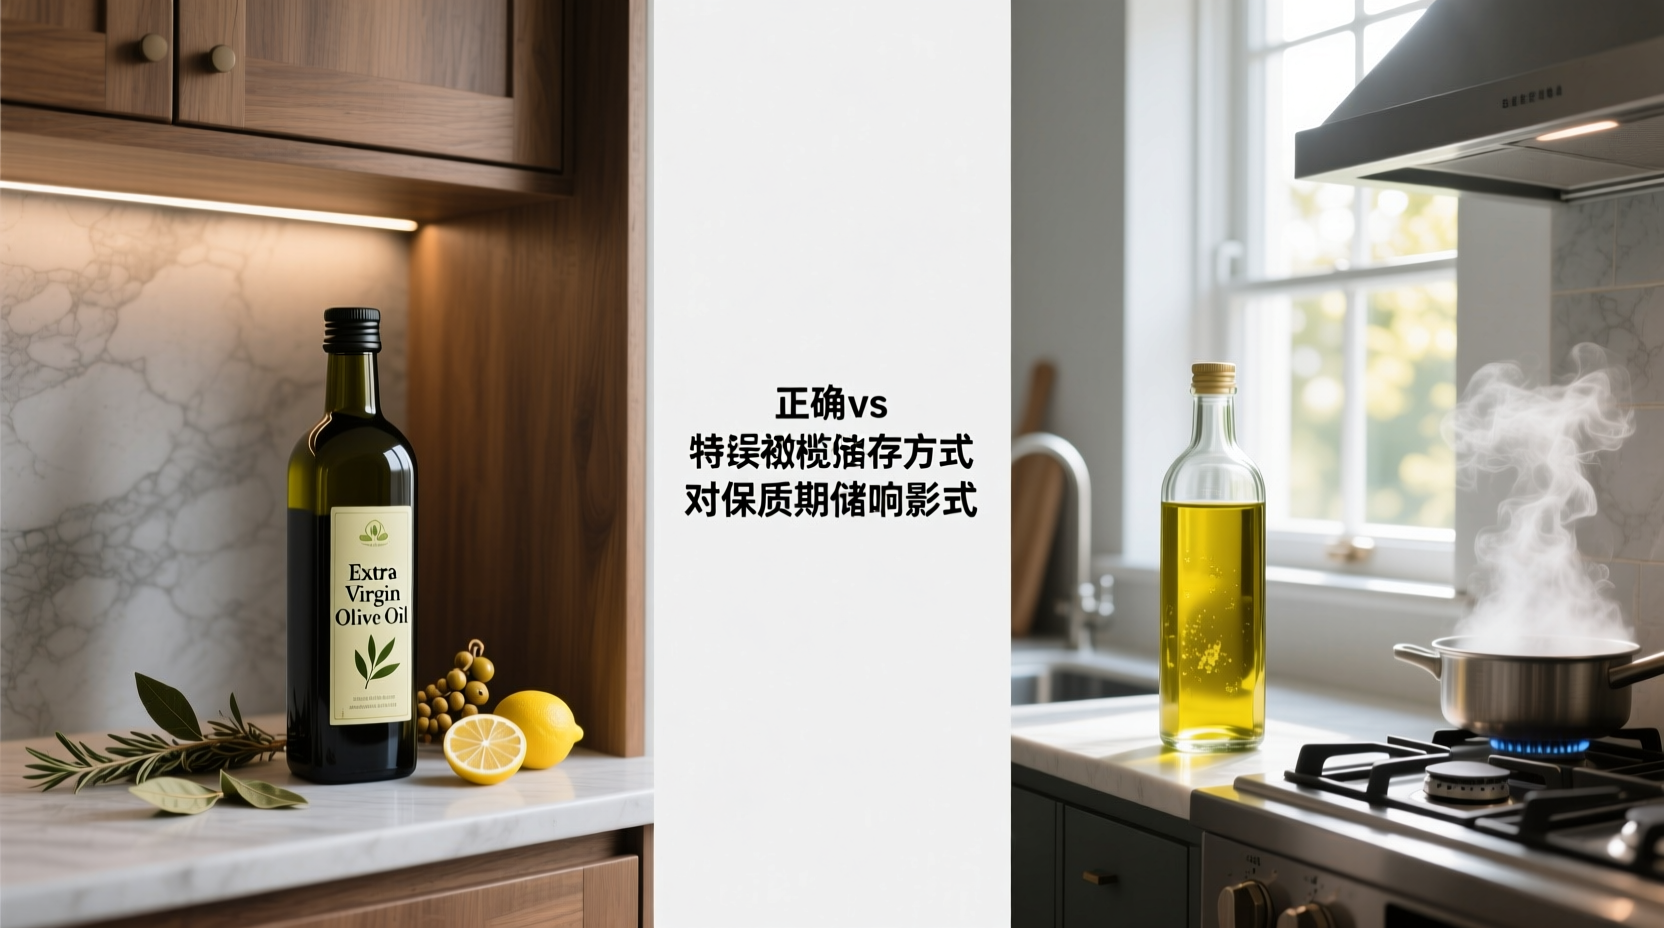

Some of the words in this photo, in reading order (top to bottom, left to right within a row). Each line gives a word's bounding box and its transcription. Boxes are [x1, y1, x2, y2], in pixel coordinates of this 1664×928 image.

[347, 563, 398, 581] Extra
[345, 585, 401, 607] Virgin
[335, 608, 381, 626] Olive
[384, 606, 409, 625] Oil
